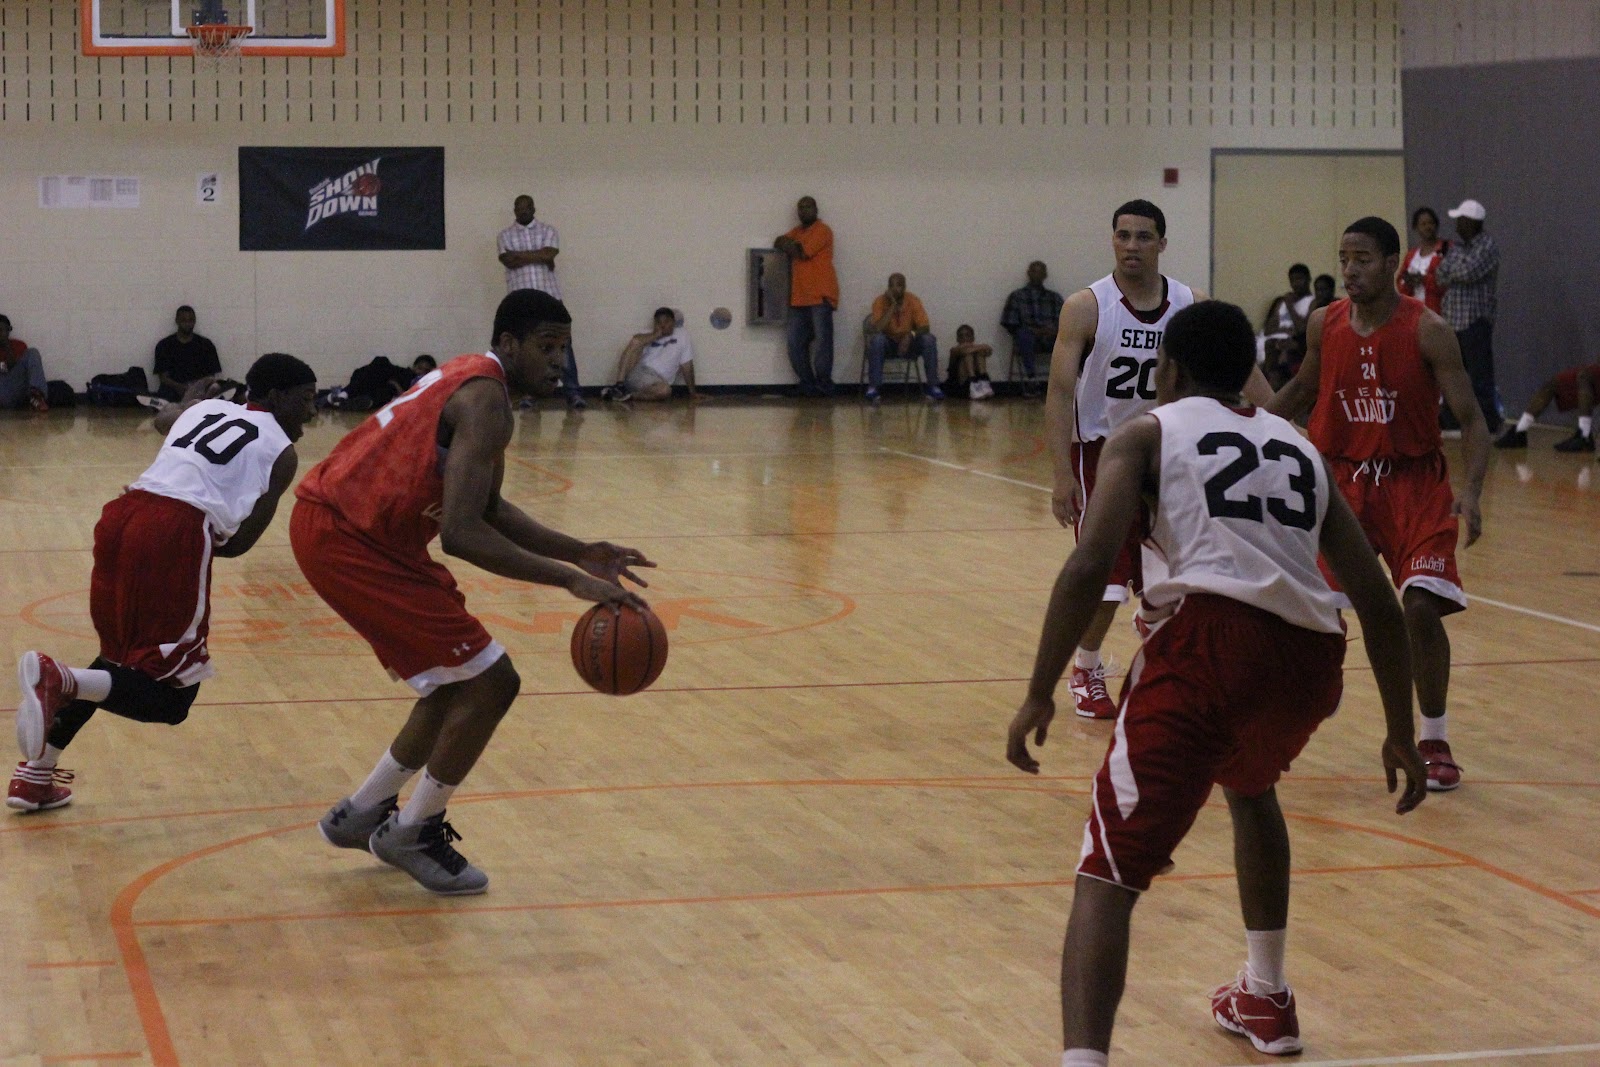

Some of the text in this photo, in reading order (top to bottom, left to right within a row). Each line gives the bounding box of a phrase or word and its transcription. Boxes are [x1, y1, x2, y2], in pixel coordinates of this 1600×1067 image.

[202, 187, 215, 201] 2
[309, 157, 381, 207] SHOW
[305, 194, 377, 231] DOWN
[1361, 363, 1376, 379] 24
[1335, 387, 1398, 399] TEAM
[171, 413, 259, 465] 10
[1196, 432, 1317, 532] 23
